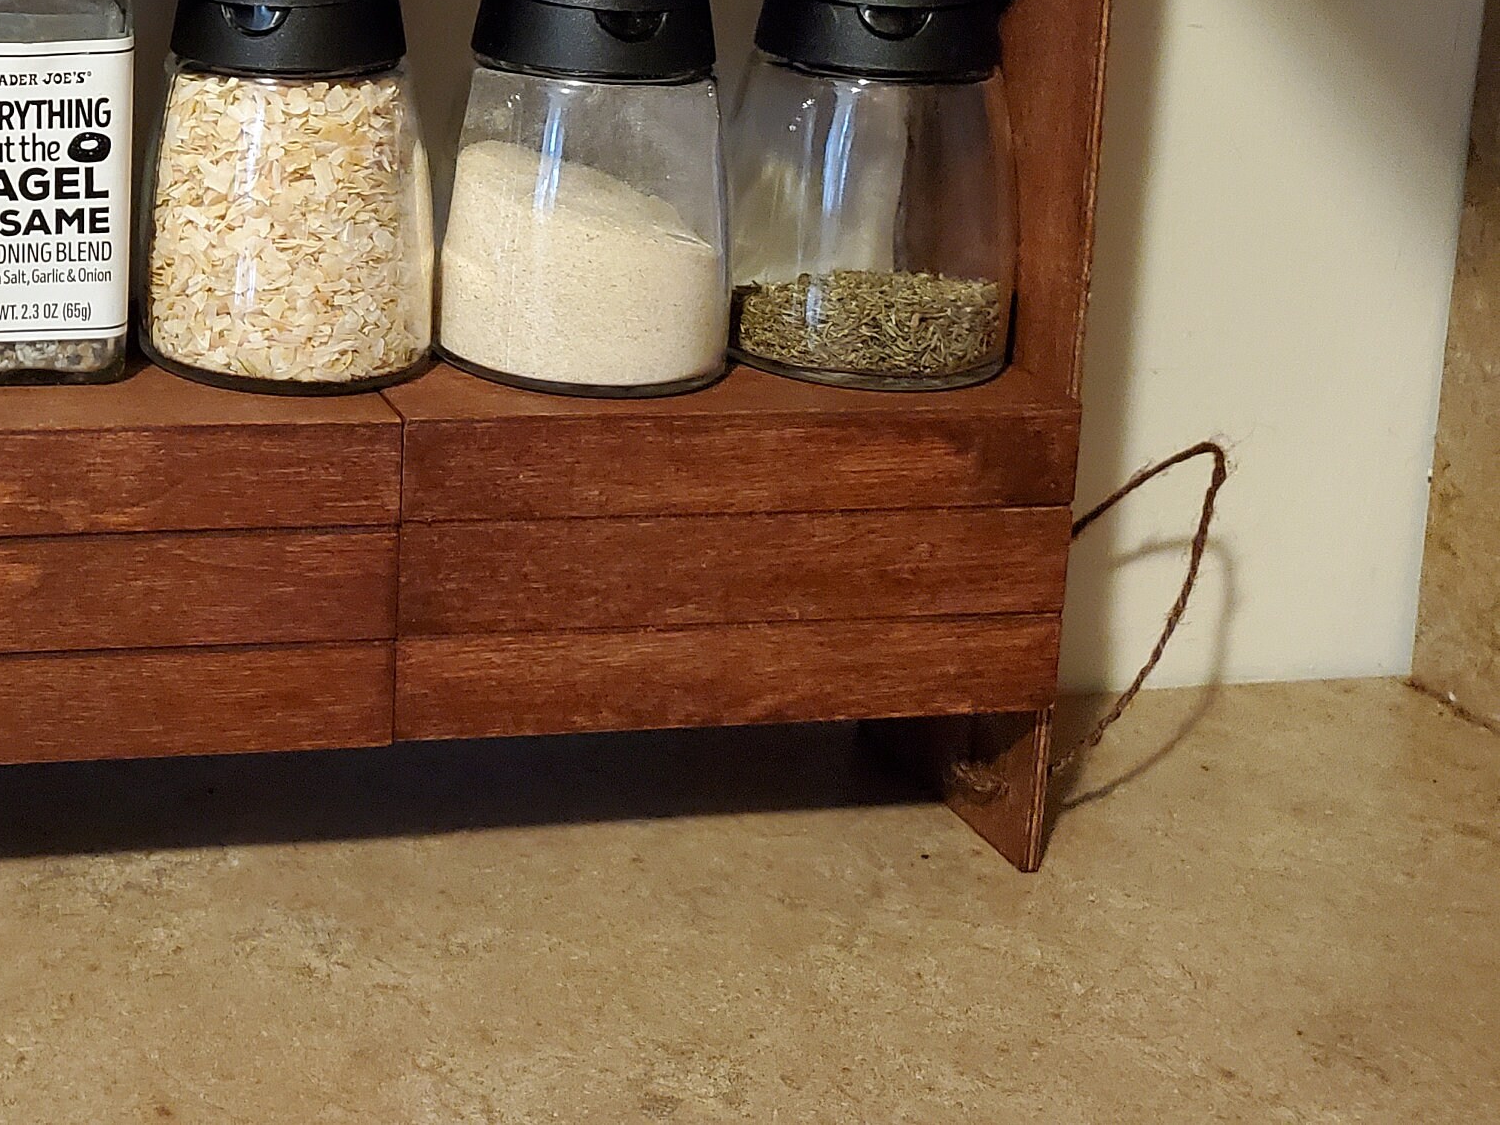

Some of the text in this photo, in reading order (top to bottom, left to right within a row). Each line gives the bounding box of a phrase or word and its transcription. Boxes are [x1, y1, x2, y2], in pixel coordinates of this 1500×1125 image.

[19, 132, 61, 162] the
[56, 241, 112, 262] BLEND
[3, 269, 30, 286] Salt,
[32, 268, 65, 283] Garlic
[66, 269, 76, 282] &
[78, 268, 112, 283] Onion
[21, 304, 39, 319] 2.3
[43, 303, 58, 319] OZ
[62, 302, 92, 321] (65g)
